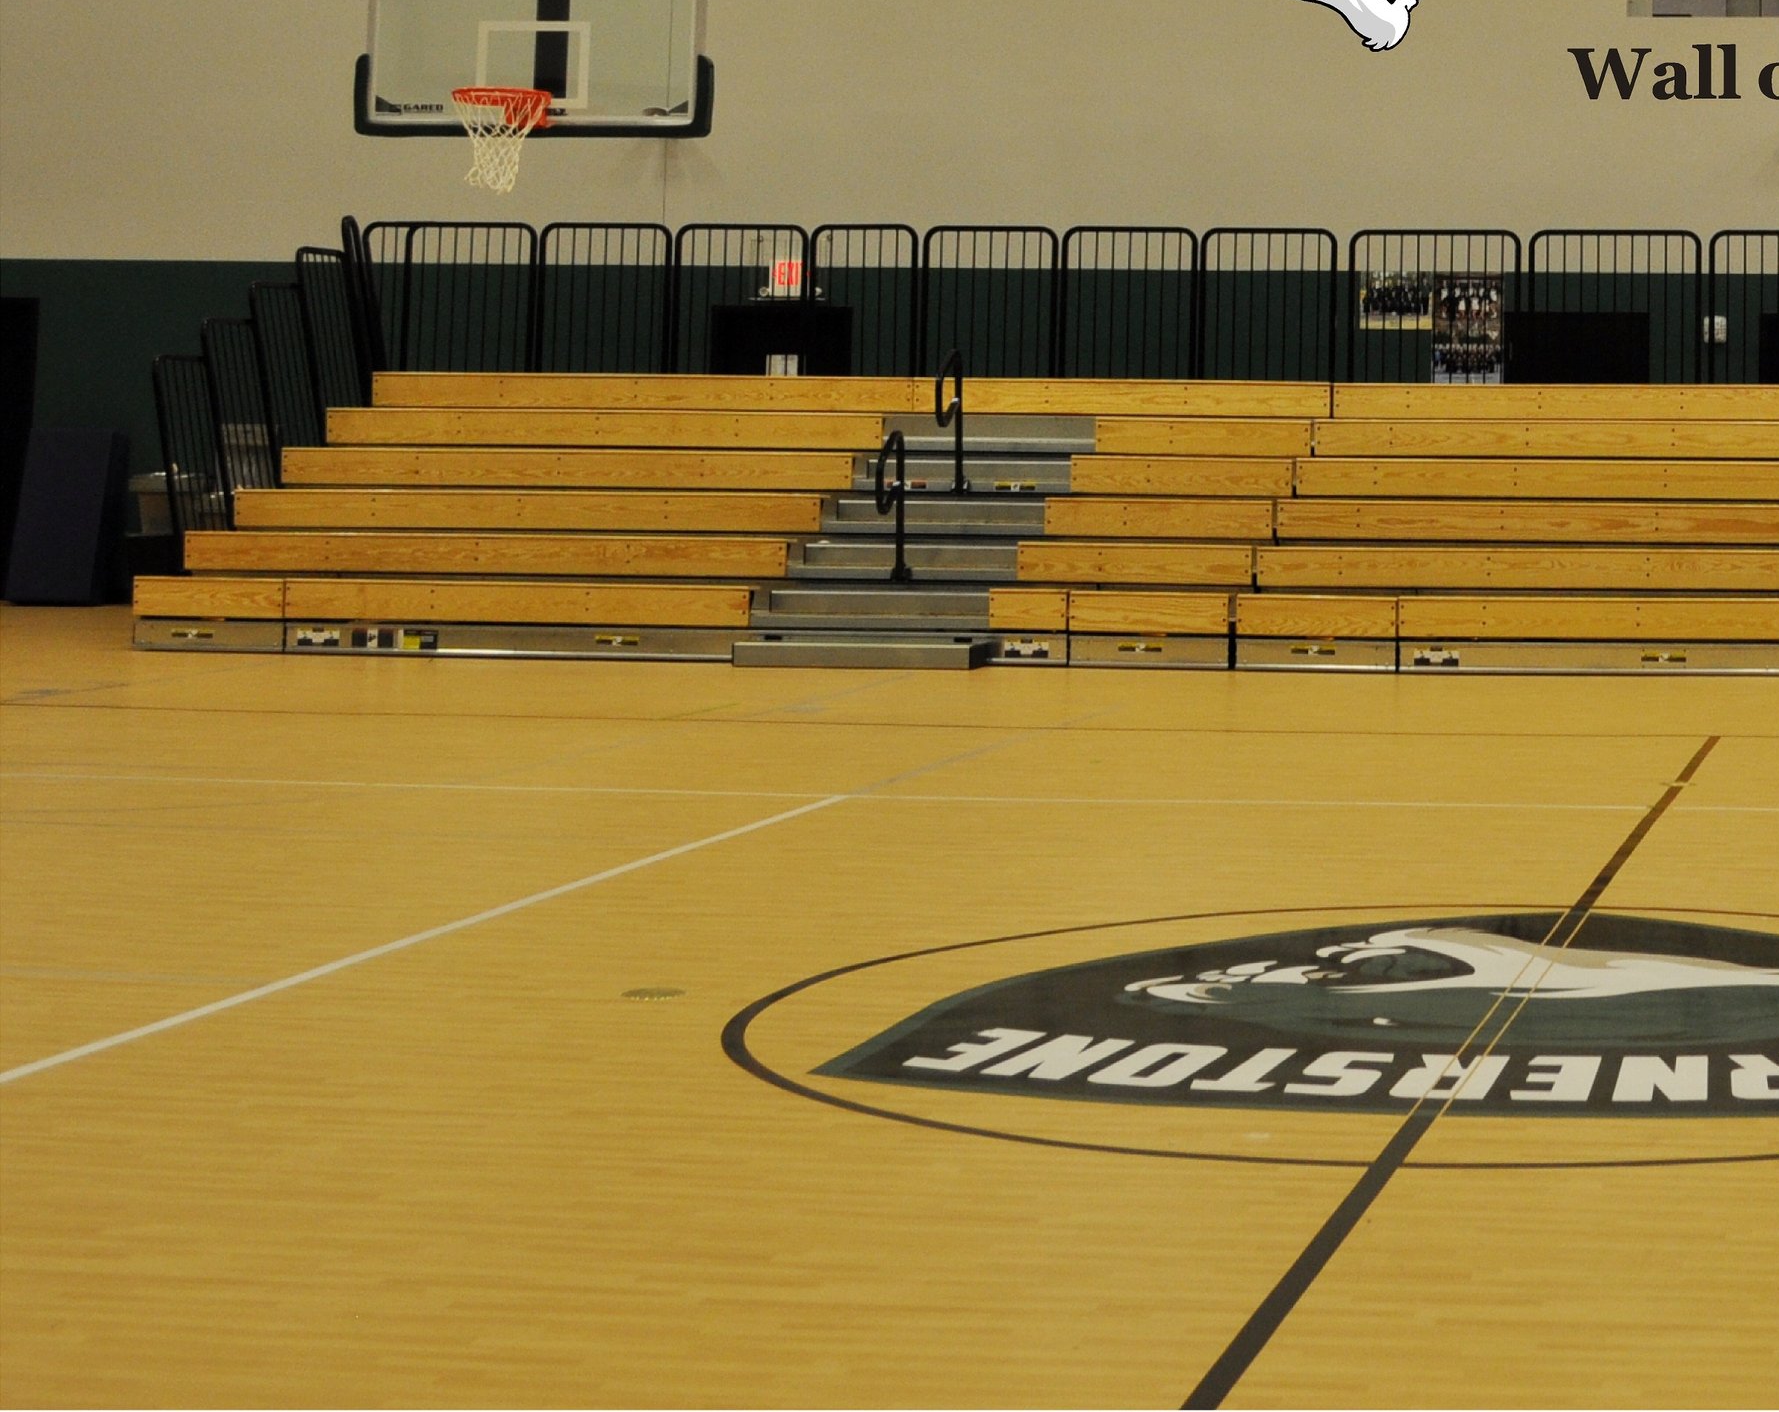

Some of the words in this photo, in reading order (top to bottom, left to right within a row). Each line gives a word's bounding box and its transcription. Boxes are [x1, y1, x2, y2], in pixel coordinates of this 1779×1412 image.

[1566, 44, 1742, 101] Wall
[403, 103, 444, 112] GARED
[777, 262, 805, 285] EXI
